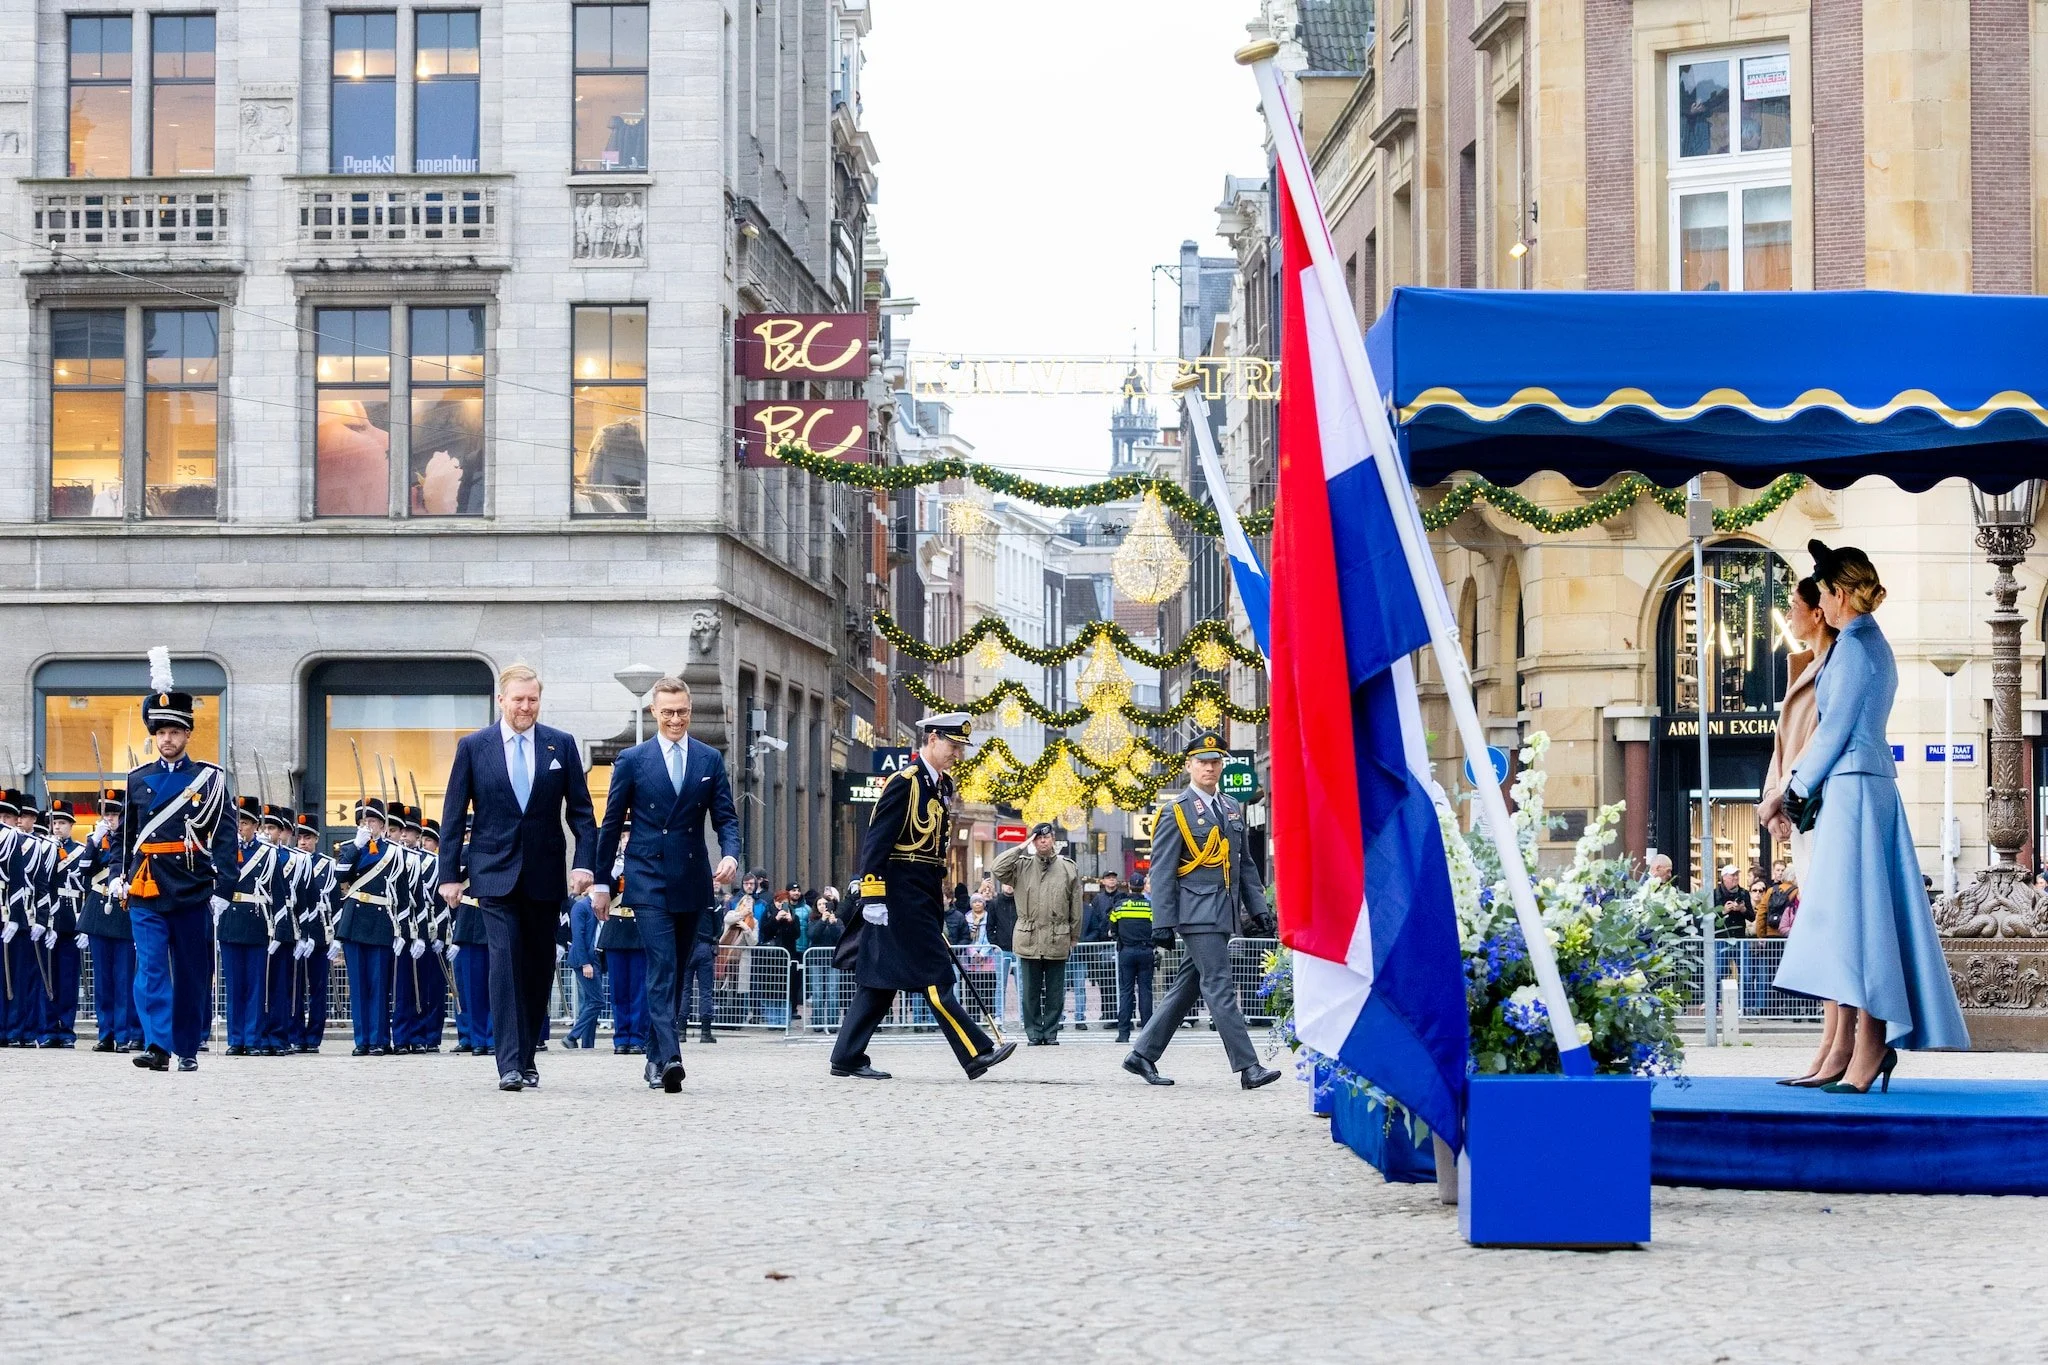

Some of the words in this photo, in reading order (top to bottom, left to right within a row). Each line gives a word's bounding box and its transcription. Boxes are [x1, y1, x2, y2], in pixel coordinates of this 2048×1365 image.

[343, 155, 395, 173] Peek&
[753, 319, 862, 372] P&C
[911, 357, 1281, 400] KALVERSTR
[754, 406, 862, 458] P&C
[1668, 722, 1724, 736] ARMNI
[1730, 719, 1777, 735] EXCHA
[1223, 773, 1252, 787] H&B
[850, 786, 883, 798] TISS
